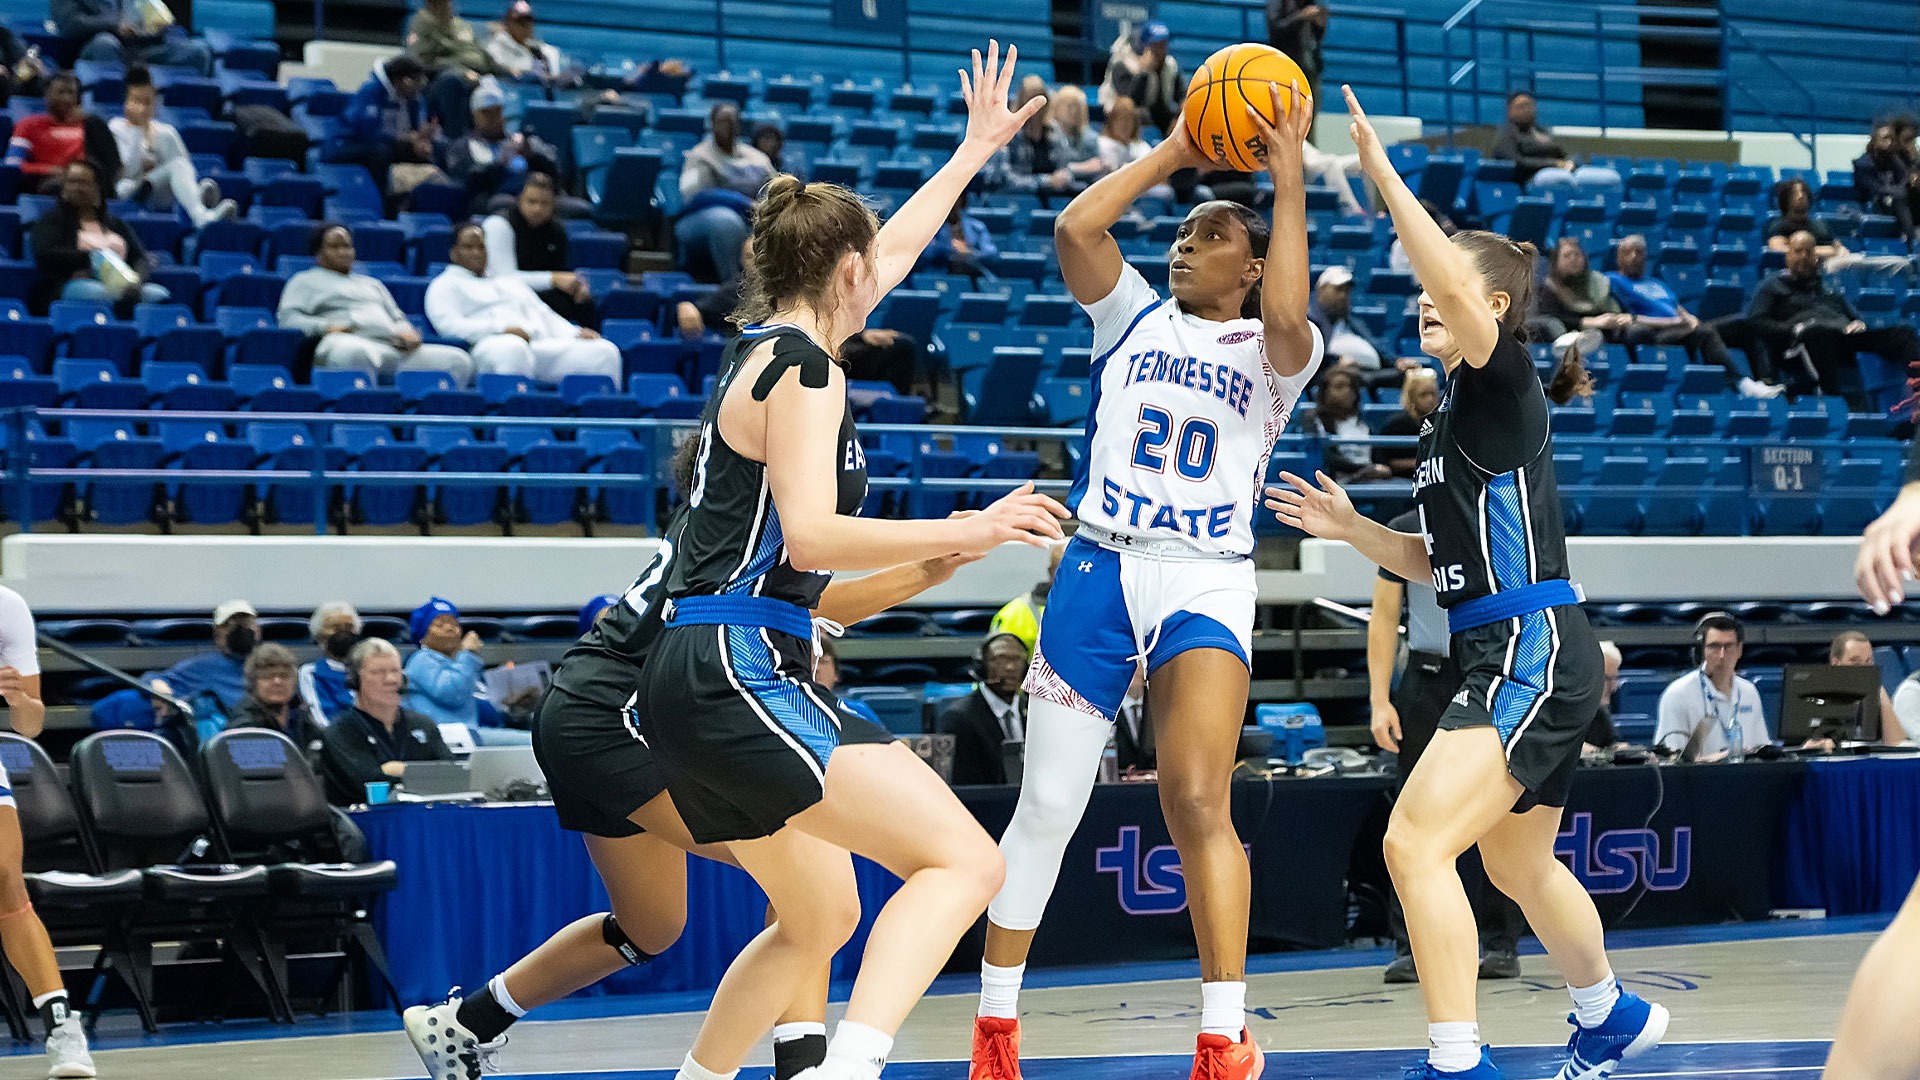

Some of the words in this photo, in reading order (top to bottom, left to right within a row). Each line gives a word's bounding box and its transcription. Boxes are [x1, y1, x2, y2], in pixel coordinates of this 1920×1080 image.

[1123, 350, 1254, 420] TENNESSEE
[1131, 403, 1218, 482] 20
[1764, 447, 1812, 464] SECTION
[1102, 476, 1237, 541] STATE
[1096, 826, 1250, 914] ts
[1553, 812, 1691, 894] tsu
